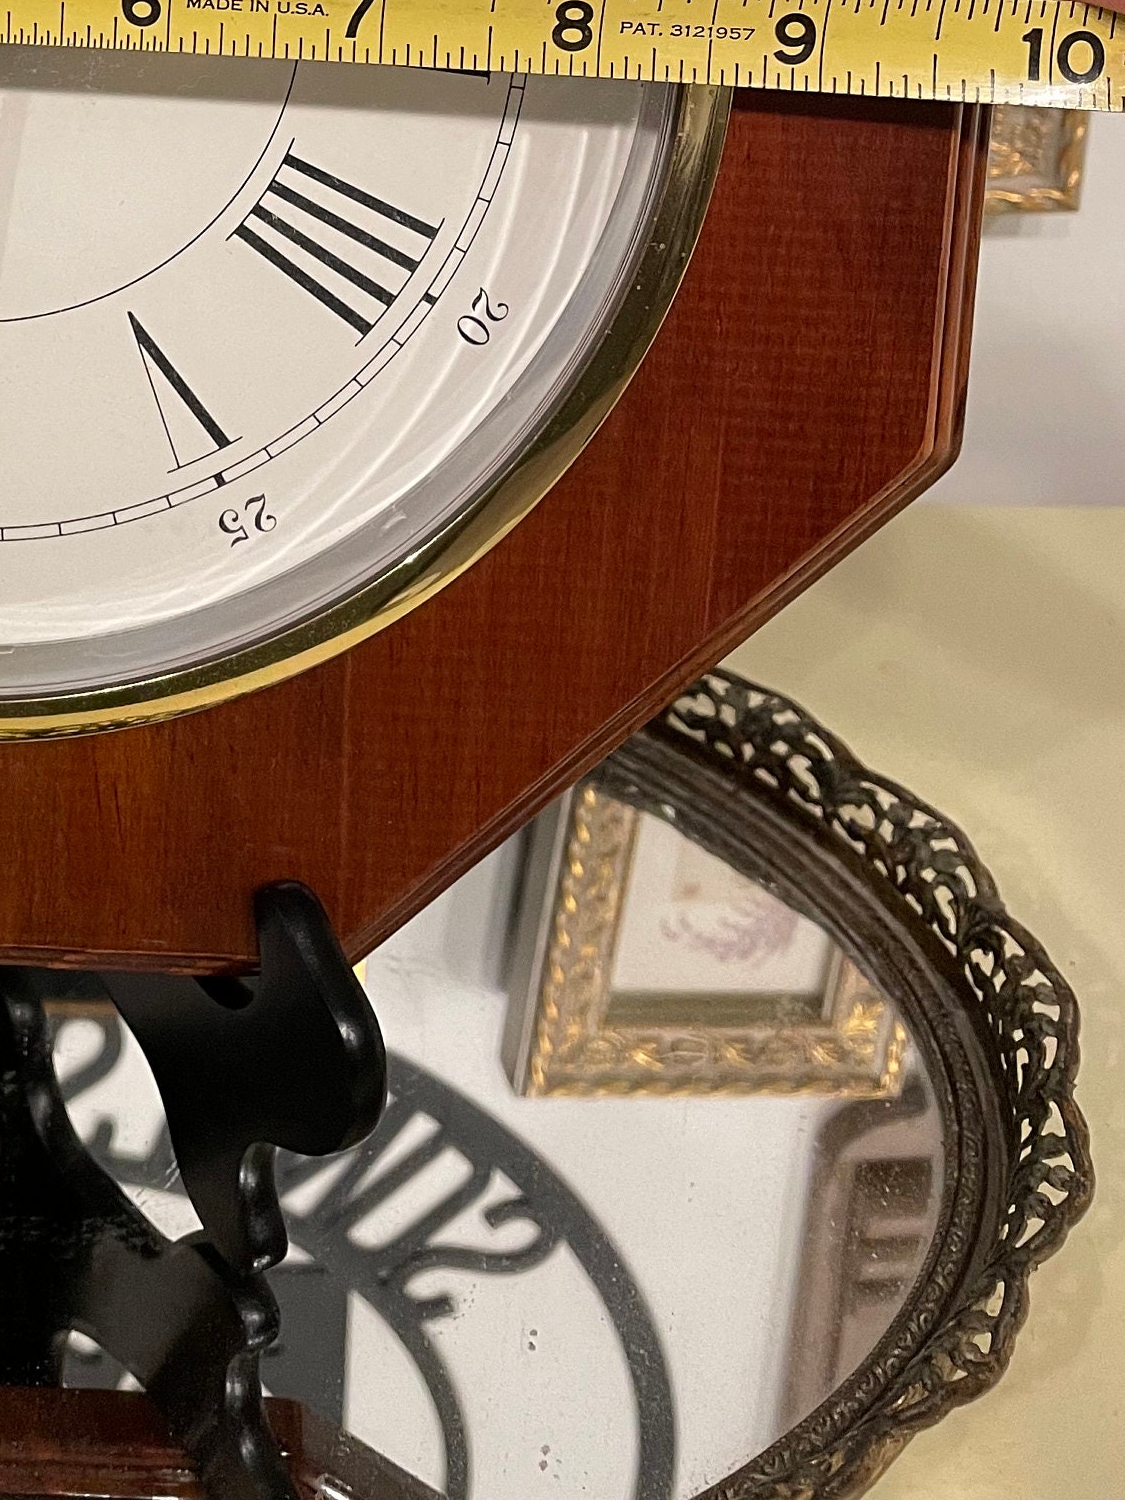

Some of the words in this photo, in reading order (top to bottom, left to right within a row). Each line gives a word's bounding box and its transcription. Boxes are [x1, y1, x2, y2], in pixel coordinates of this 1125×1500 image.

[249, 0, 269, 14] IN
[276, 0, 330, 18] U.S.A.
[551, 0, 594, 52] 8
[619, 20, 663, 38] PAT.
[669, 24, 756, 42] 3121957
[774, 12, 817, 65] 9
[1021, 27, 1105, 84] 10
[456, 286, 509, 347] 20
[127, 310, 243, 474] V
[218, 493, 278, 548] 25
